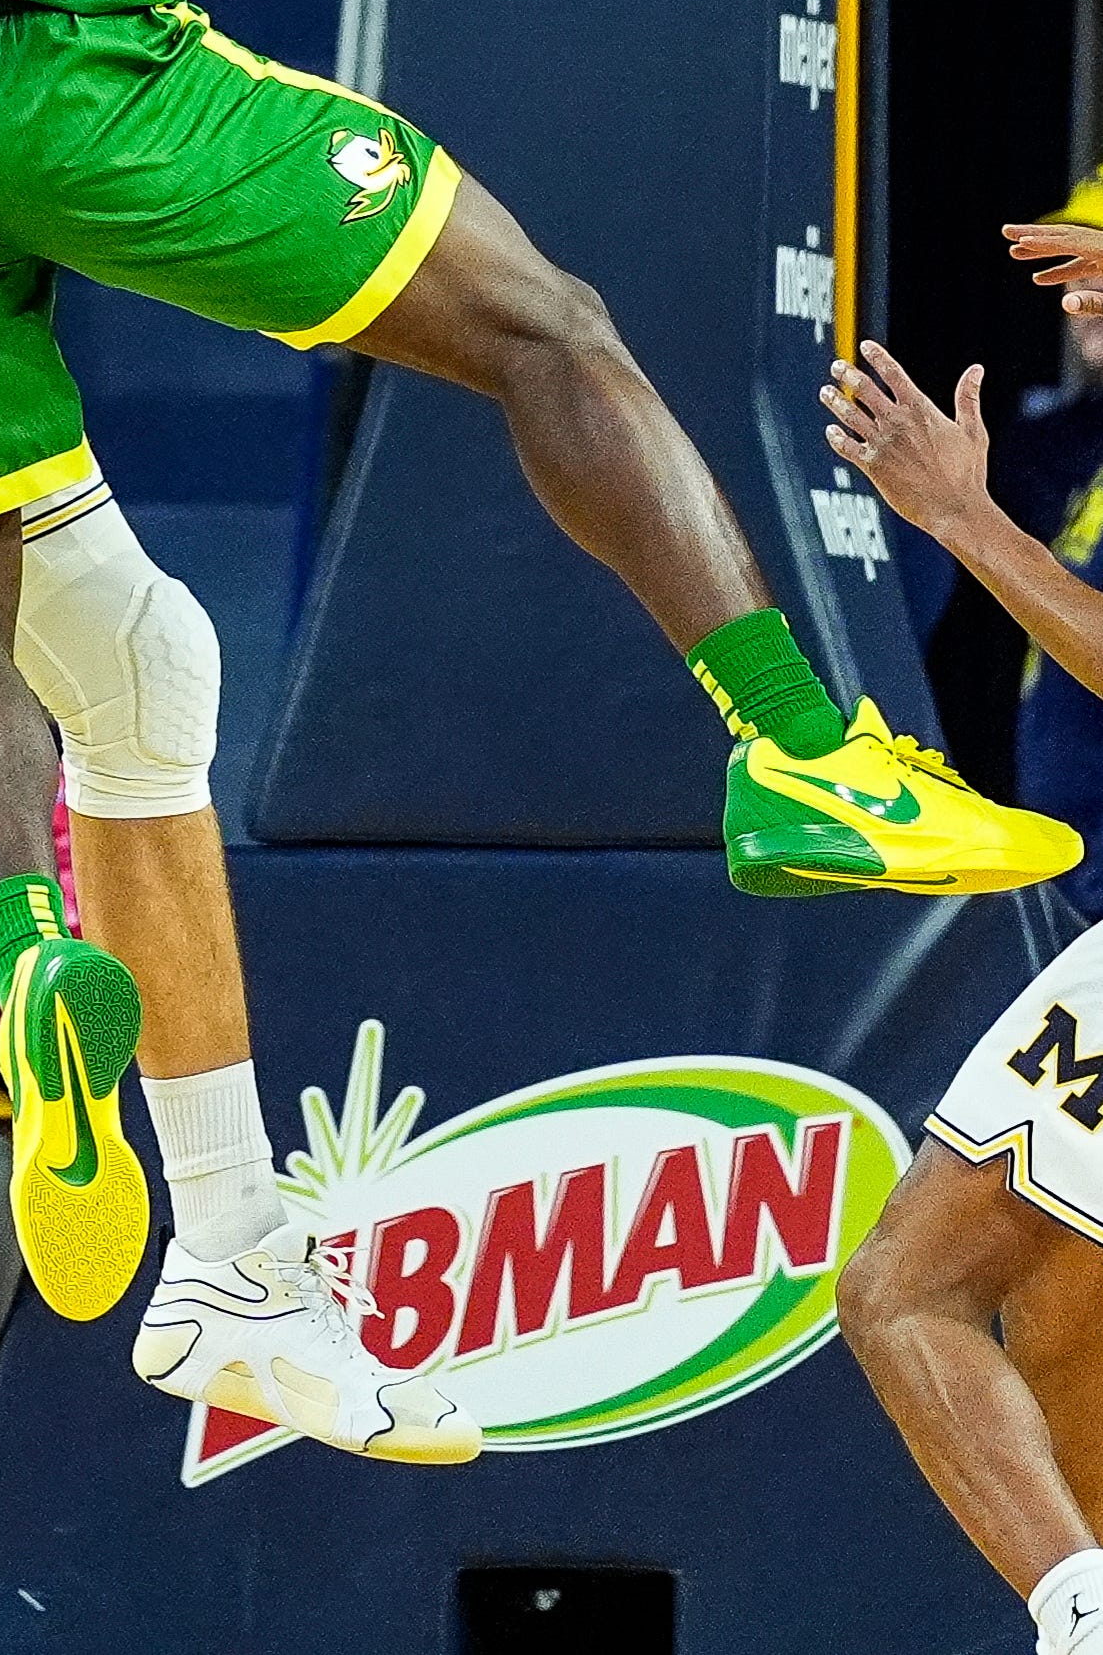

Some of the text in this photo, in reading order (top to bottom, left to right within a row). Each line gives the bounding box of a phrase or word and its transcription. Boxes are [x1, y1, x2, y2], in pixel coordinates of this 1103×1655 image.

[809, 465, 891, 583] meijer
[1005, 1002, 1103, 1134] M
[320, 1121, 844, 1371] BMAN
